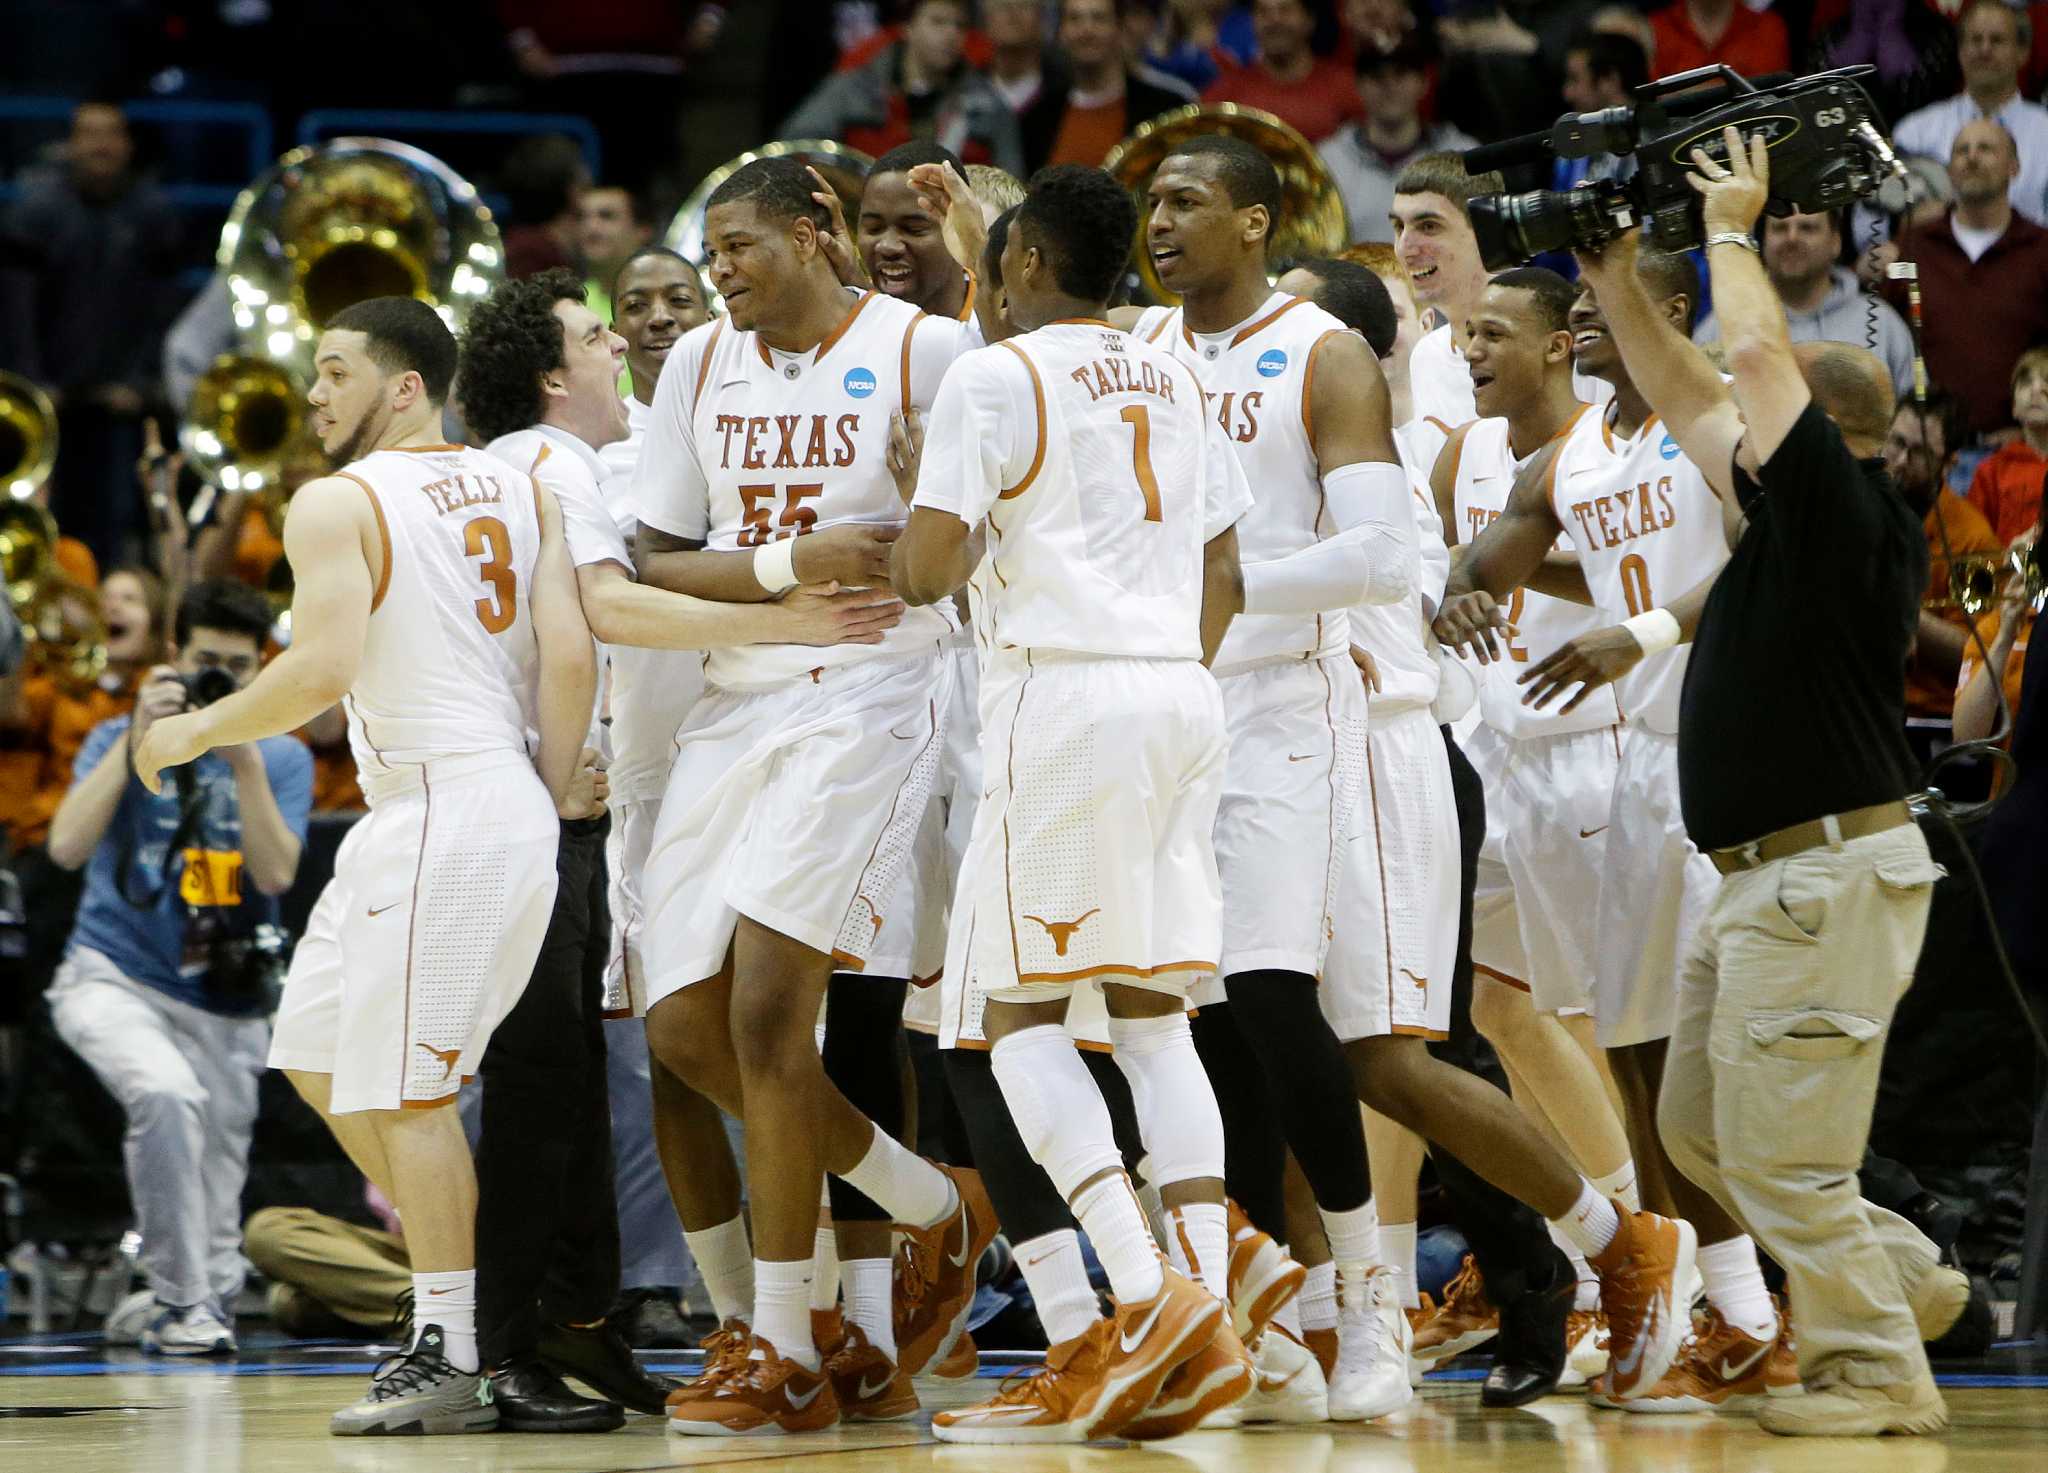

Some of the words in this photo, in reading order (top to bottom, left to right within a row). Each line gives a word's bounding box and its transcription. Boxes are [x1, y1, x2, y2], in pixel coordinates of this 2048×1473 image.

[1815, 106, 1846, 128] 63
[1071, 357, 1175, 404] TAYLOR
[716, 413, 860, 470] TEXAS
[1120, 404, 1163, 523] 1
[736, 482, 824, 547] 55
[1571, 475, 1676, 552] TEXAS
[463, 515, 518, 635] 3
